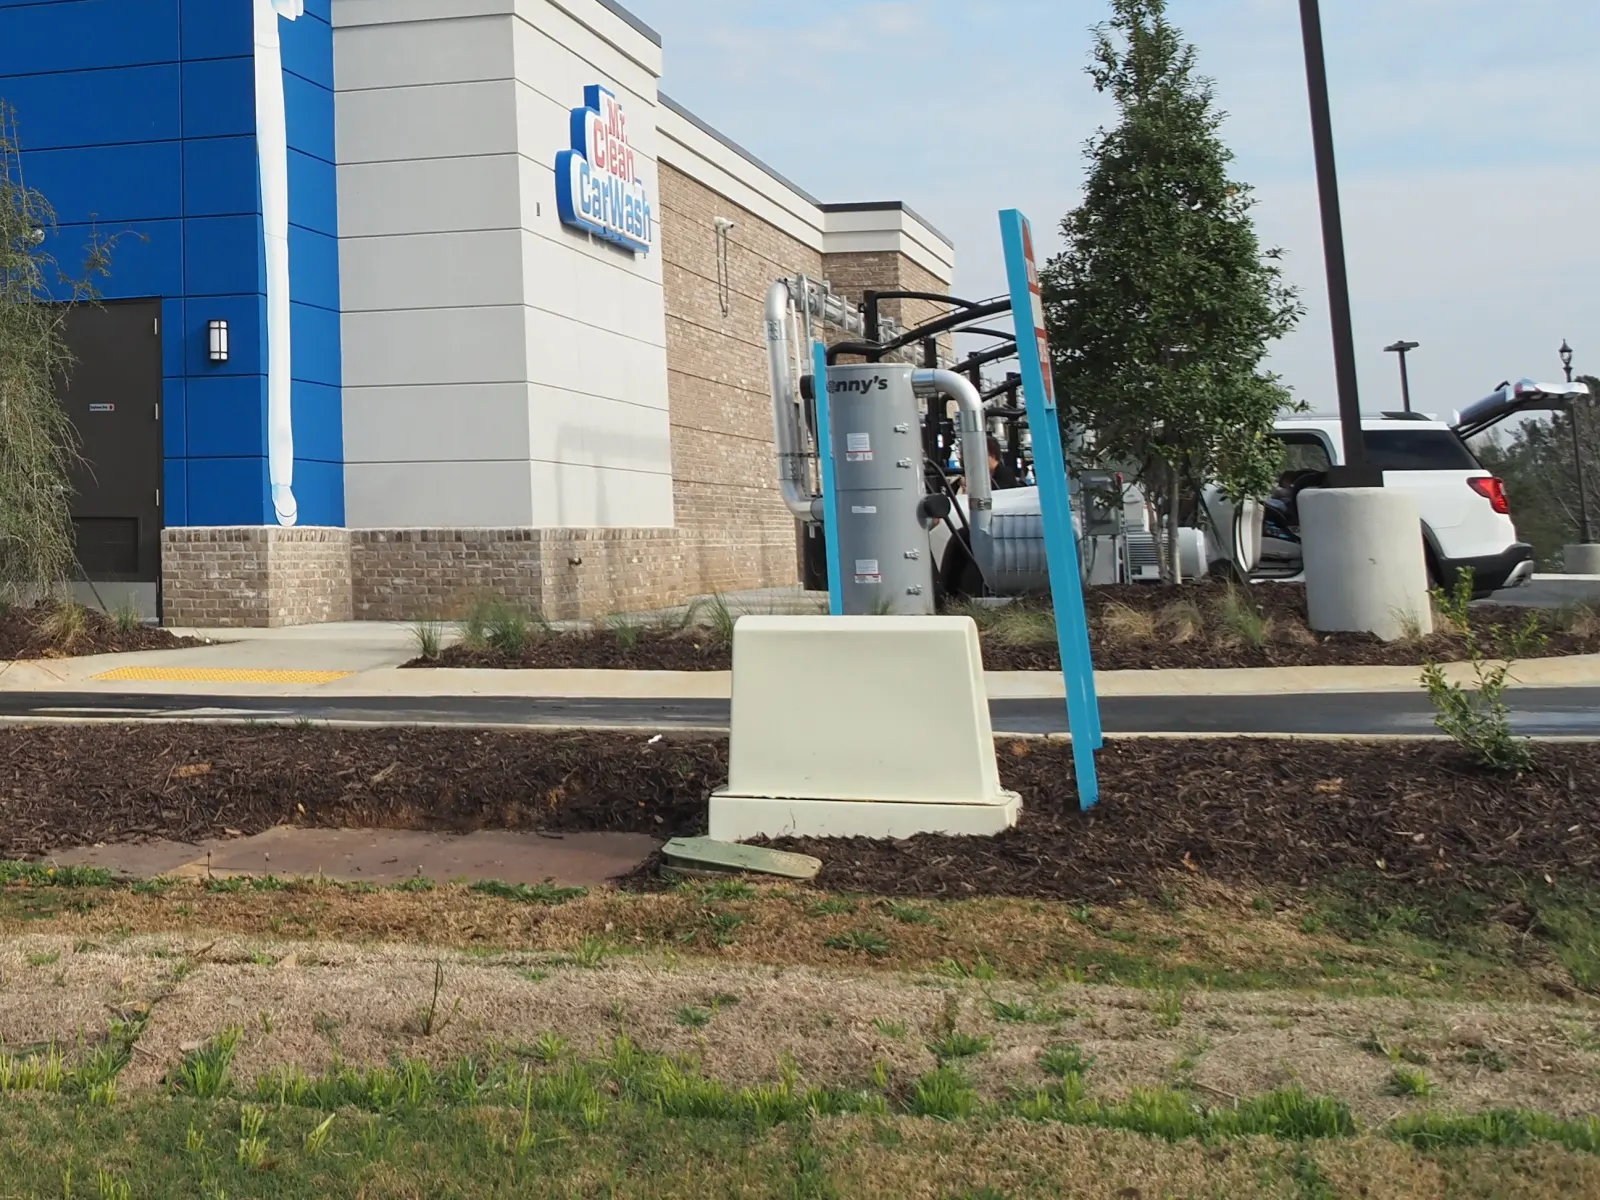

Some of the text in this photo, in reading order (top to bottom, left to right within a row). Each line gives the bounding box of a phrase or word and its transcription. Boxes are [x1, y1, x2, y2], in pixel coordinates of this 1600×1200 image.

[593, 117, 635, 186] Clean
[606, 97, 628, 144] Mr.
[579, 162, 652, 243] CarWash
